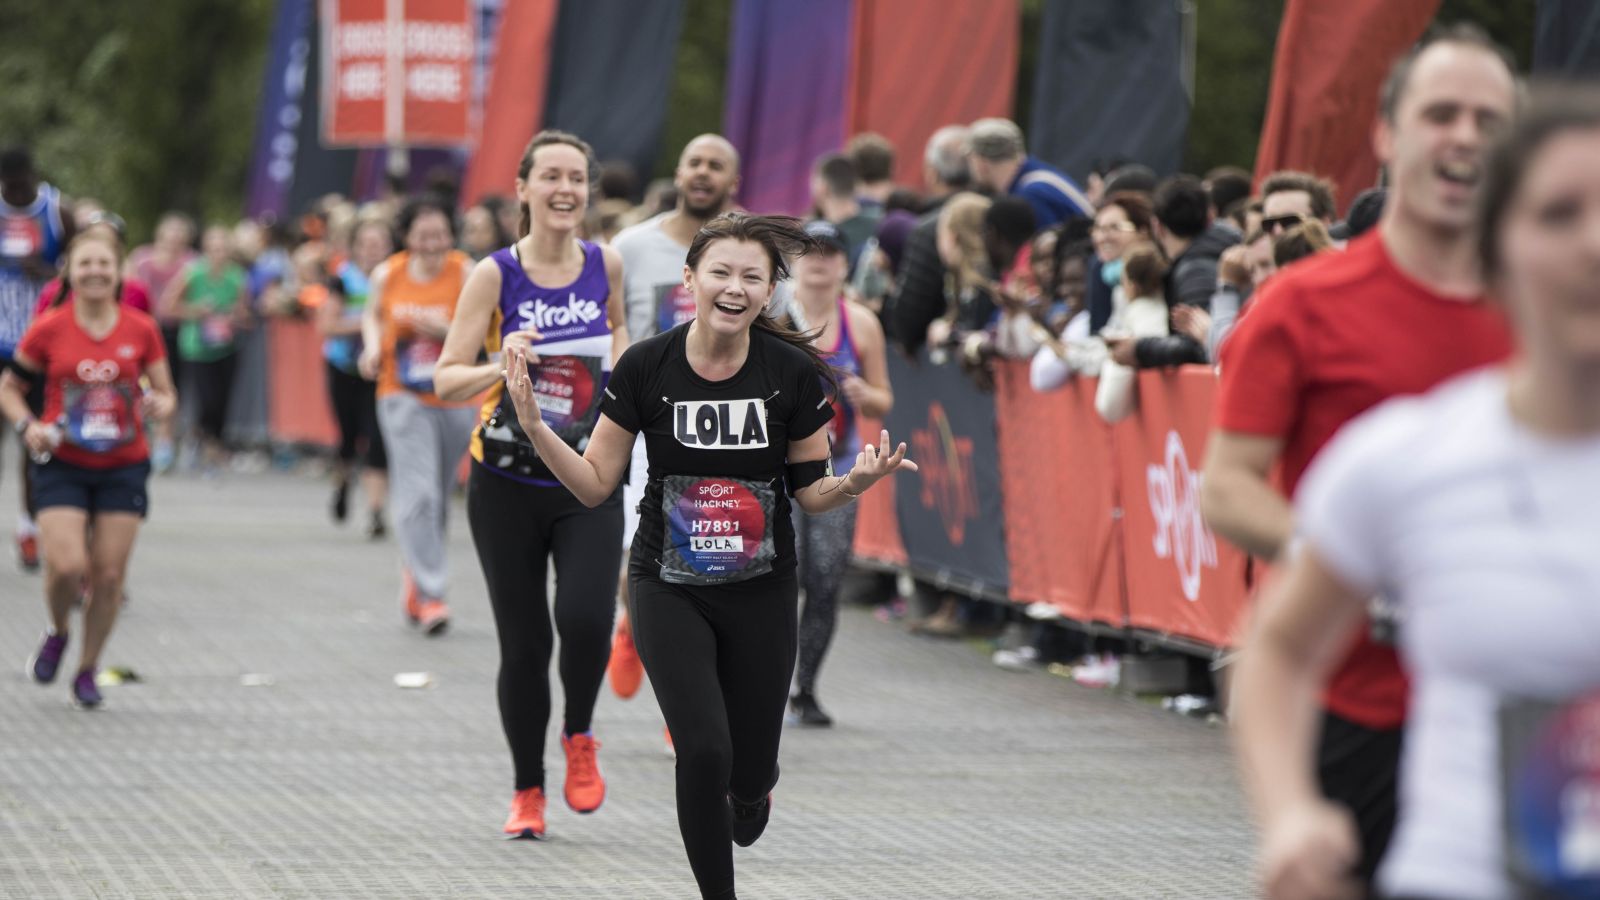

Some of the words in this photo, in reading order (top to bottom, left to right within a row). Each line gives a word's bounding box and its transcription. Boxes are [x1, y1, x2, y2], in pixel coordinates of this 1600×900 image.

[518, 292, 601, 330] Stroke
[676, 402, 766, 446] LOLA
[699, 483, 735, 498] SPORT
[694, 499, 741, 508] HACKNEY
[692, 519, 740, 533] H7891
[695, 538, 733, 550] LOLA
